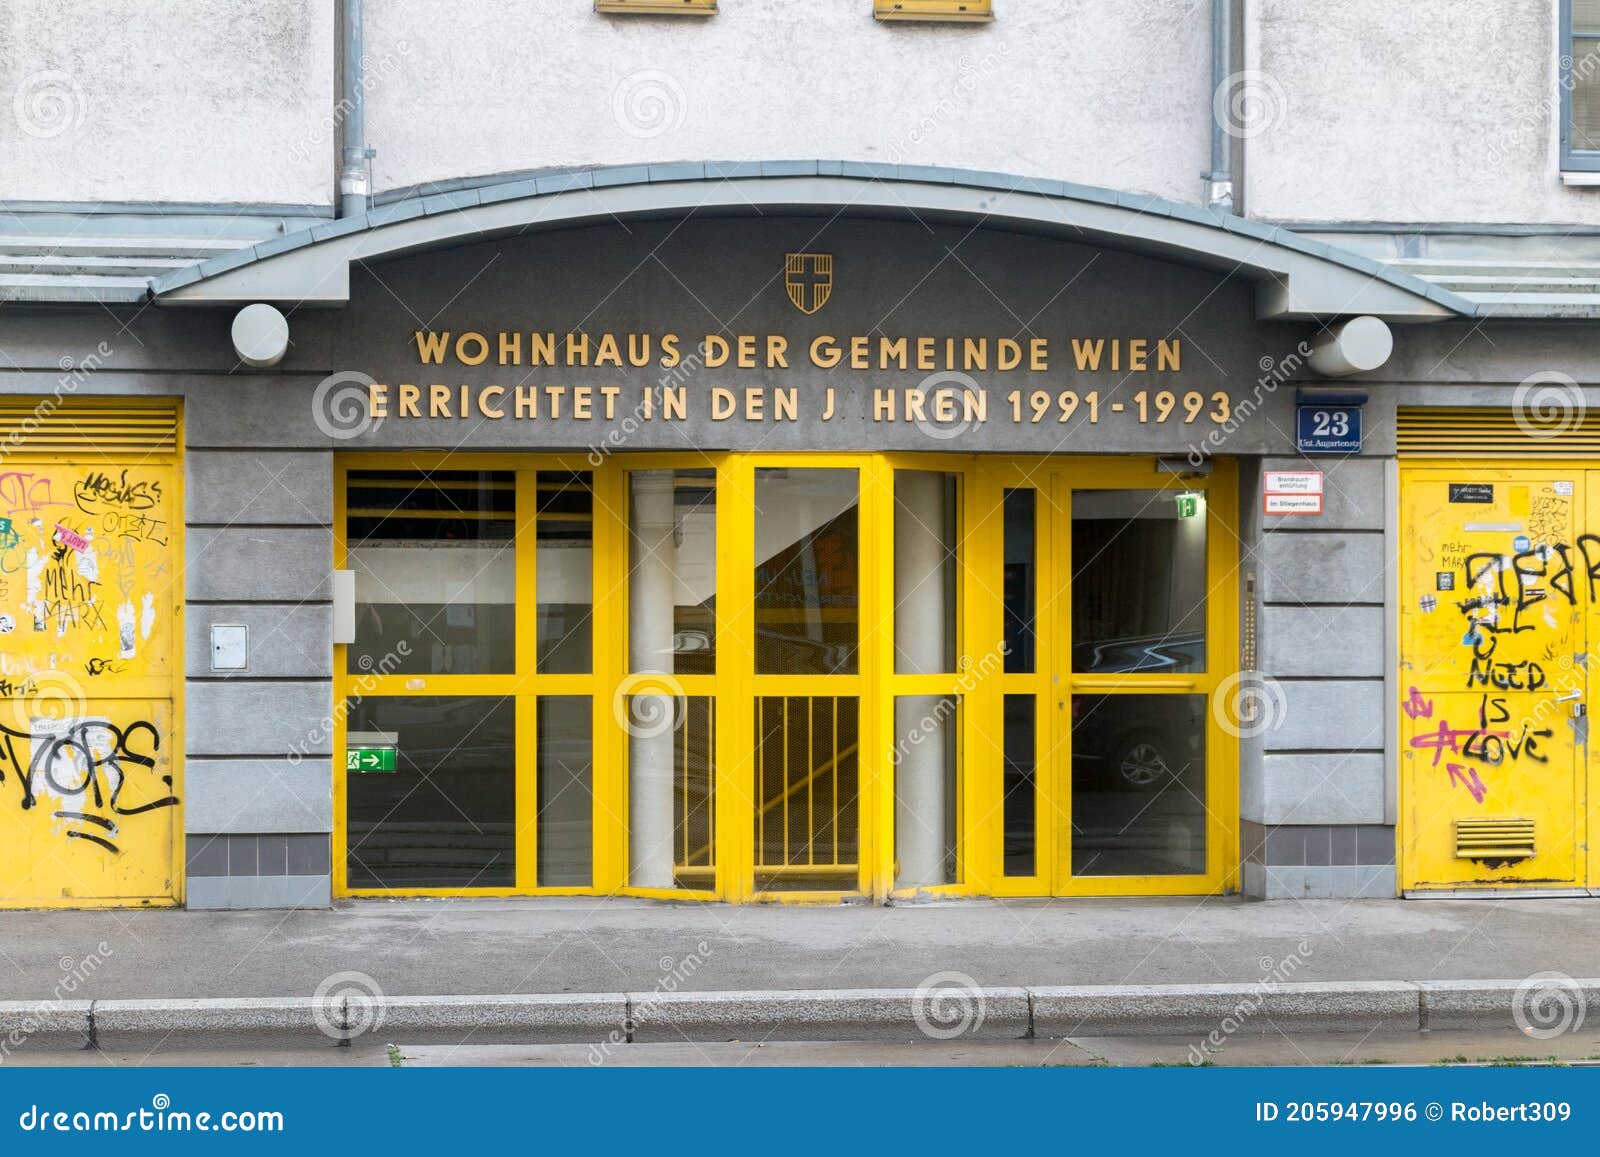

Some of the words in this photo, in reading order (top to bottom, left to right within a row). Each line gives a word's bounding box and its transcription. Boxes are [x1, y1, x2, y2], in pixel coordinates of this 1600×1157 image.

[416, 331, 681, 368] WOHNHAUS
[705, 335, 789, 369] DER
[809, 335, 1048, 371] GEMEINDE
[1071, 338, 1181, 372] WIEN
[369, 384, 620, 420] ERRICHTET
[643, 386, 687, 421] IN
[711, 387, 798, 422] DEN
[1008, 390, 1231, 424] 1991-1993
[1312, 410, 1349, 437] 23
[44, 600, 108, 632] MARX
[1480, 693, 1510, 730] IS
